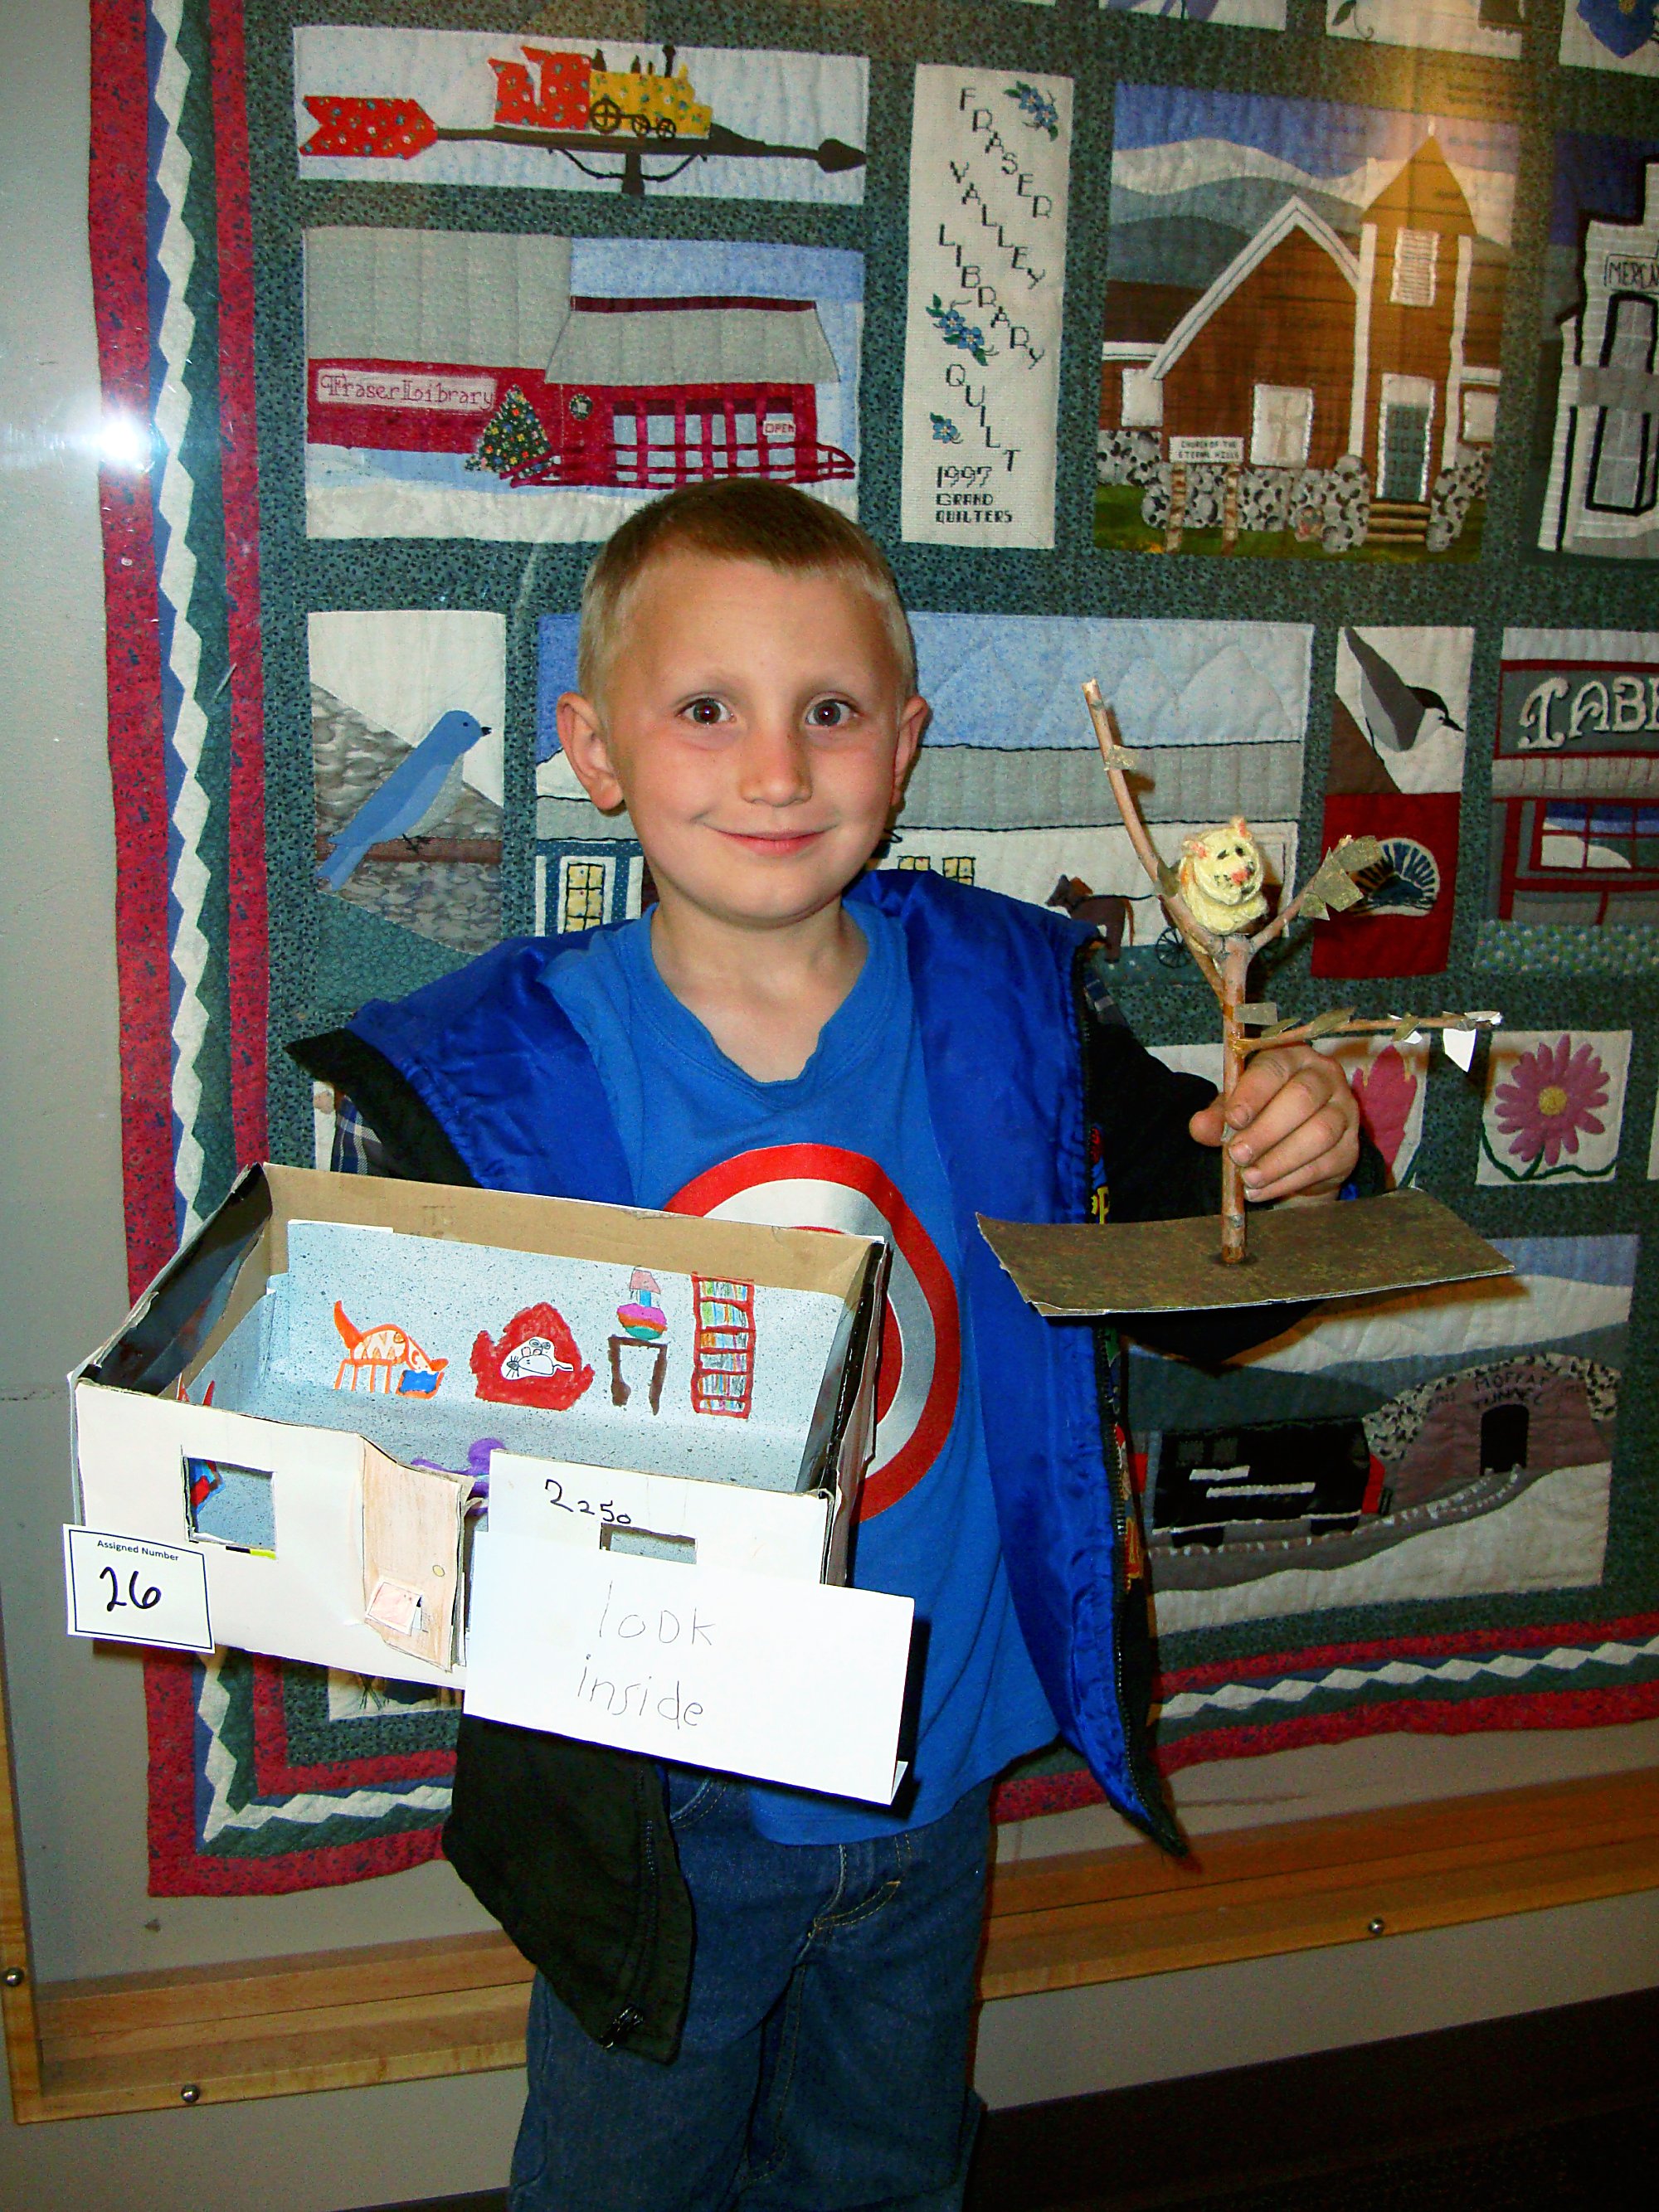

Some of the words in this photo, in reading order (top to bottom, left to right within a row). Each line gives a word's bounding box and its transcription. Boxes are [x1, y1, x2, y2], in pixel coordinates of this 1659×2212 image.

[958, 86, 1053, 219] FRASER
[950, 160, 1045, 290] VALLEY
[1609, 261, 1659, 289] MERCA
[939, 223, 1044, 370] LIBRARY
[320, 373, 400, 400] Fraser
[401, 380, 494, 410] Library
[765, 423, 795, 434] OPEN
[946, 364, 1020, 472] QUILT
[937, 466, 992, 489] 1997
[936, 493, 994, 506] GRAND
[936, 509, 1013, 524] QUILTERS
[97, 1539, 139, 1553] Assigned
[141, 1547, 179, 1561] Number
[100, 1566, 162, 1612] 26
[577, 1653, 703, 1729] inside
